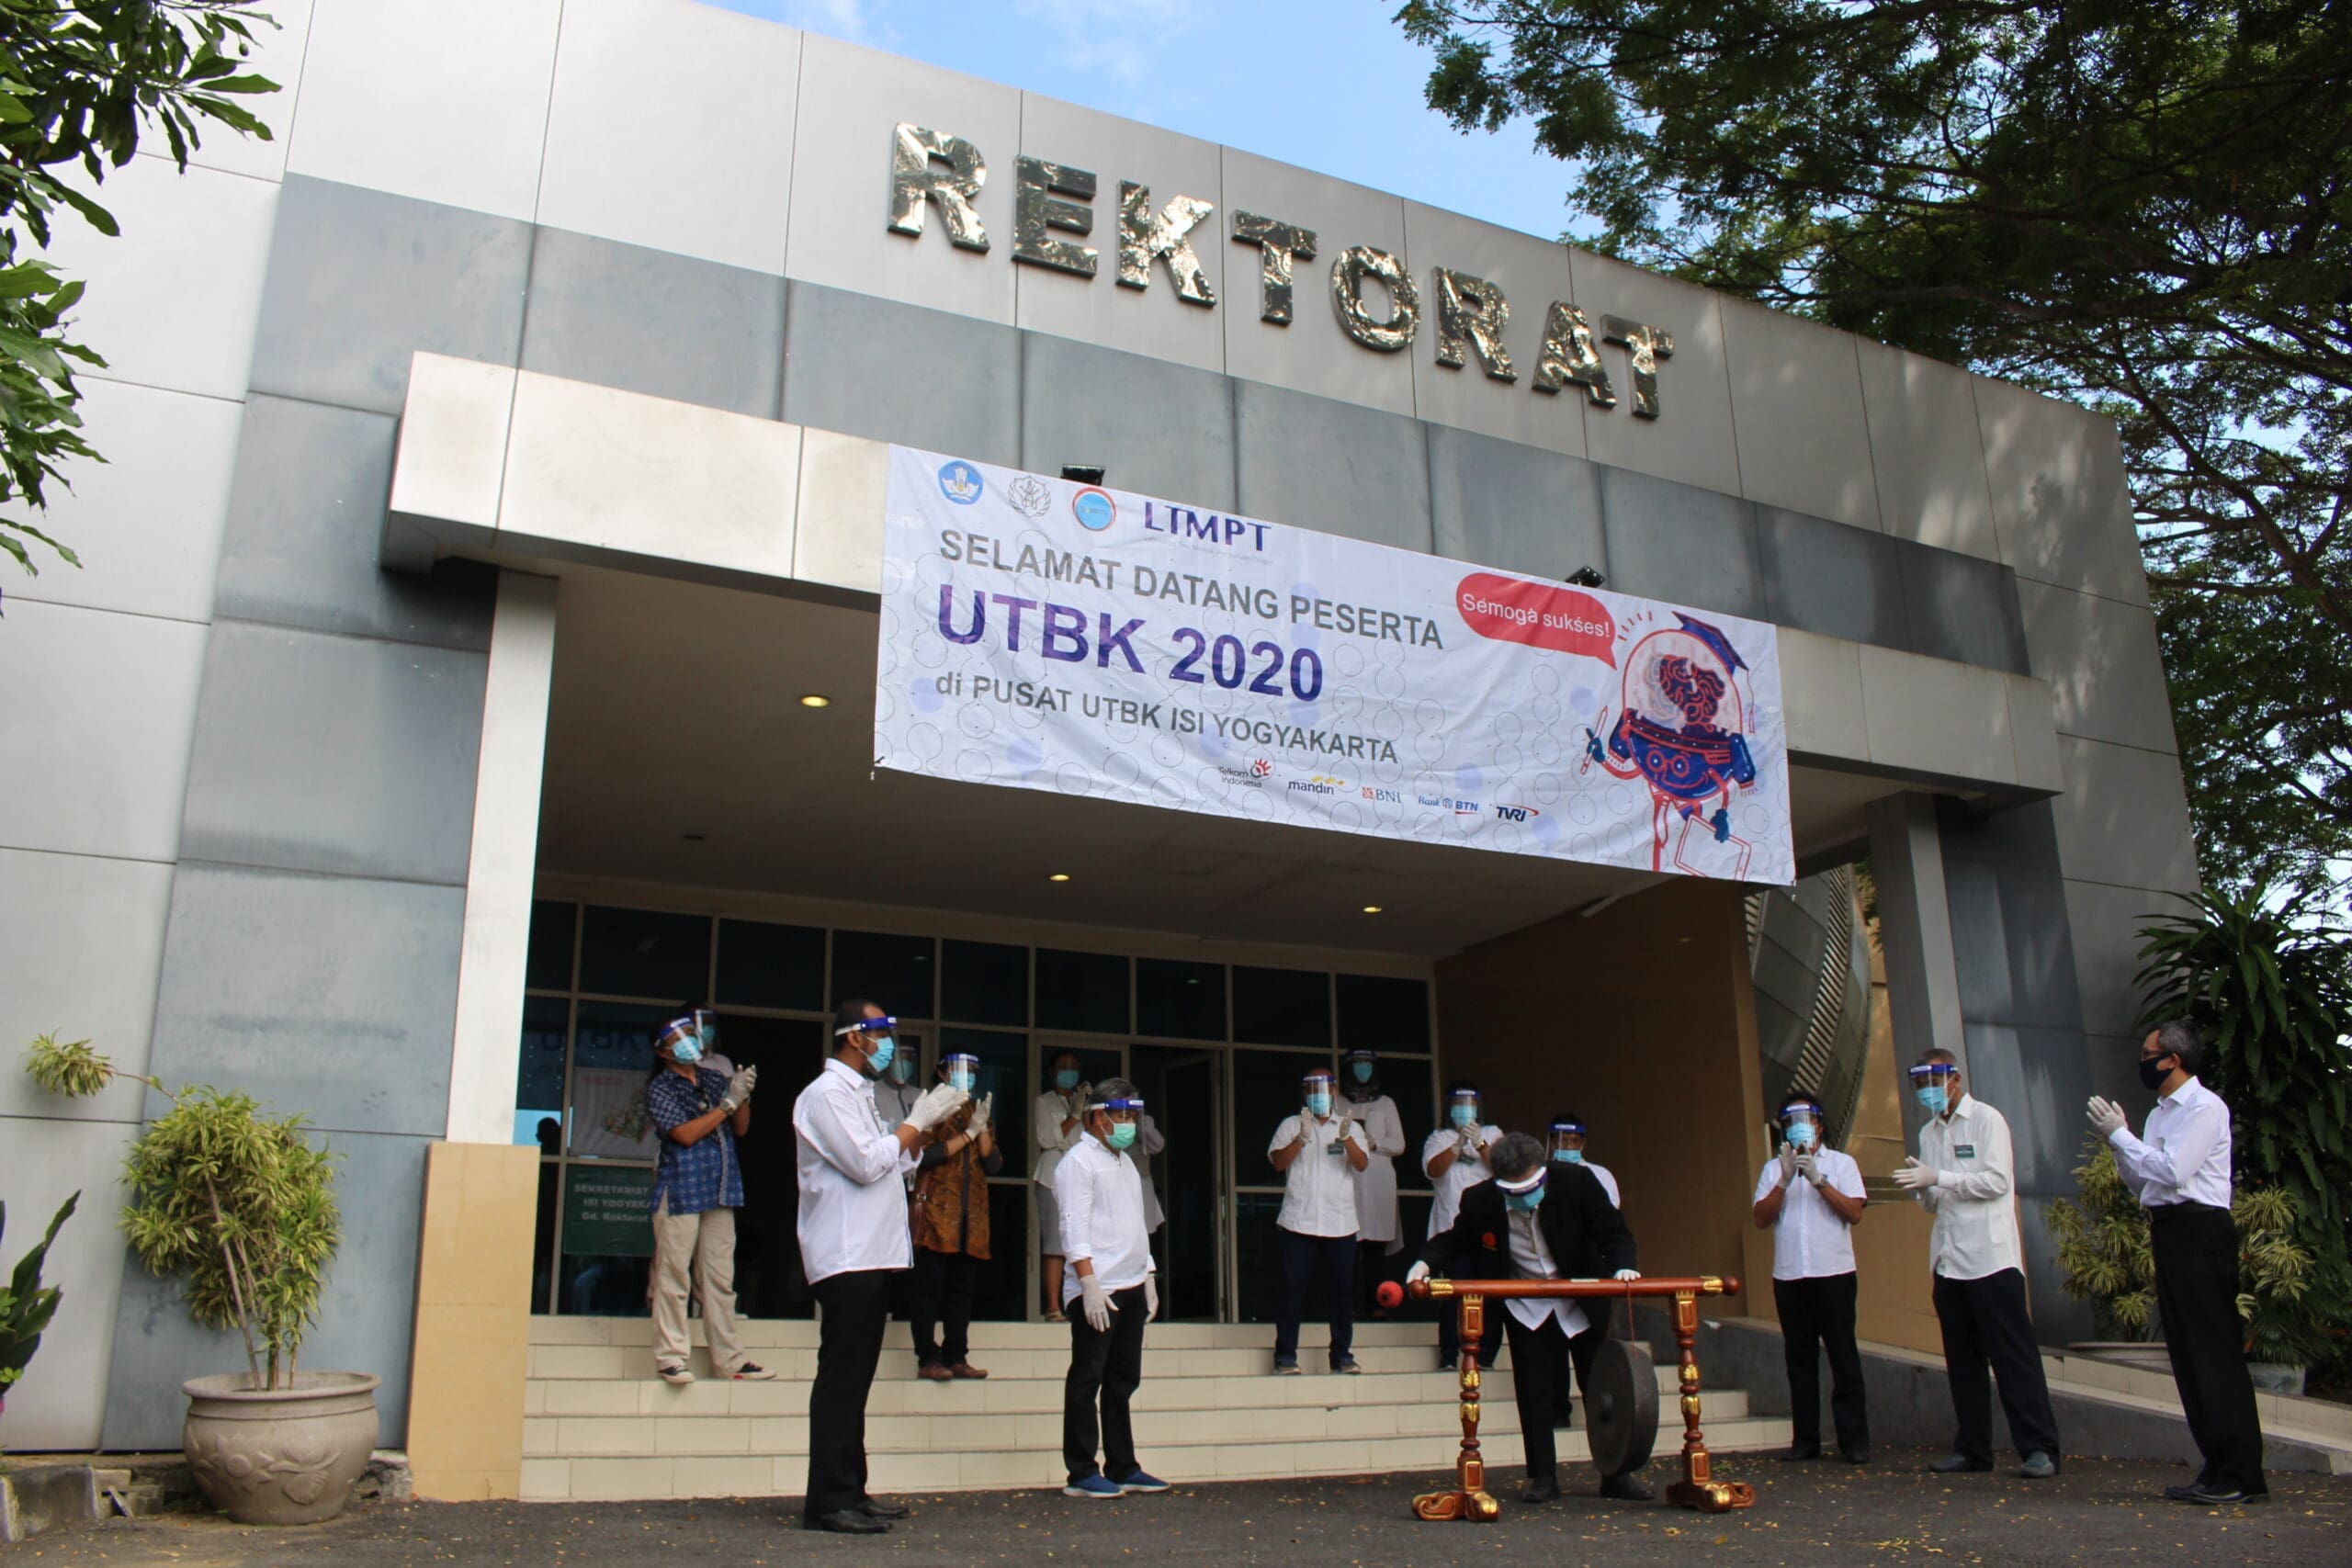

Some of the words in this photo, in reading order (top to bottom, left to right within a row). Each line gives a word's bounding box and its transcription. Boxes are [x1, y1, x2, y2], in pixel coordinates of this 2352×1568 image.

[888, 121, 1675, 421] REKTORAT
[1145, 502, 1272, 551] LTMPT
[939, 529, 1121, 591] SELAMAT
[1134, 566, 1278, 619] DATANG
[1290, 593, 1443, 650] PESERTA
[1463, 592, 1539, 625] Semoga
[1543, 612, 1610, 638] sukses!
[938, 583, 1147, 674] UTBK
[1170, 627, 1324, 703] 2020
[935, 671, 962, 696] di
[973, 678, 1072, 713] PUSAT
[1082, 696, 1164, 730] UTBK
[1170, 707, 1204, 735] ISI
[1214, 715, 1398, 764] YOGYAKARTA
[1218, 767, 1249, 778] Telkom
[1222, 776, 1262, 788] Indonesia
[1375, 788, 1402, 803] BNI
[1455, 800, 1479, 811] BTN
[1496, 806, 1528, 822] TVRI
[573, 1184, 649, 1195] SEKRETARIAT
[601, 1199, 650, 1209] YOGYAK
